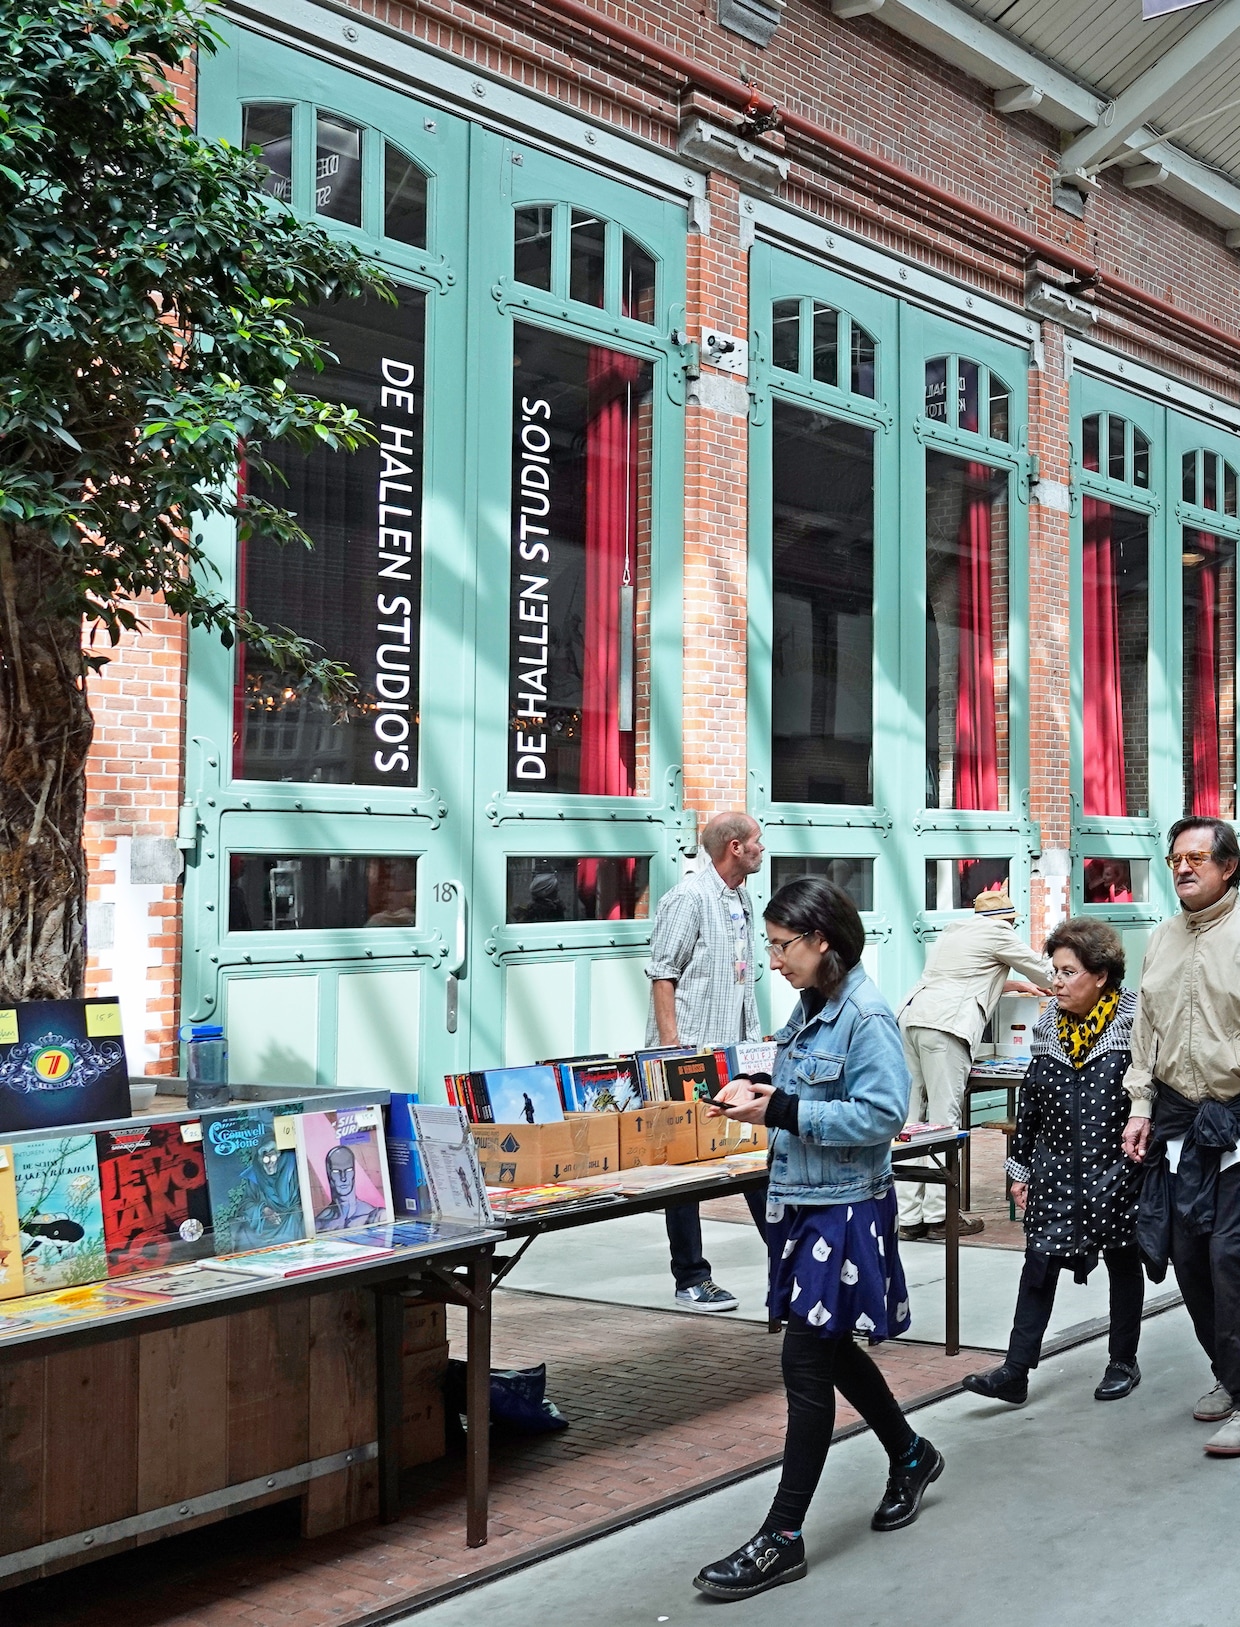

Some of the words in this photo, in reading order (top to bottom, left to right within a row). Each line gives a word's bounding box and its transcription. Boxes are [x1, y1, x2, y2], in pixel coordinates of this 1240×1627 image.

[381, 357, 415, 414] DE
[377, 424, 413, 580] HALLEN
[519, 397, 551, 563] STUDIO'S
[374, 593, 411, 772] STUDIO'S
[518, 575, 549, 717] HALLEN
[517, 733, 547, 779] DE
[433, 882, 452, 902] 18
[214, 1138, 259, 1156] Stone
